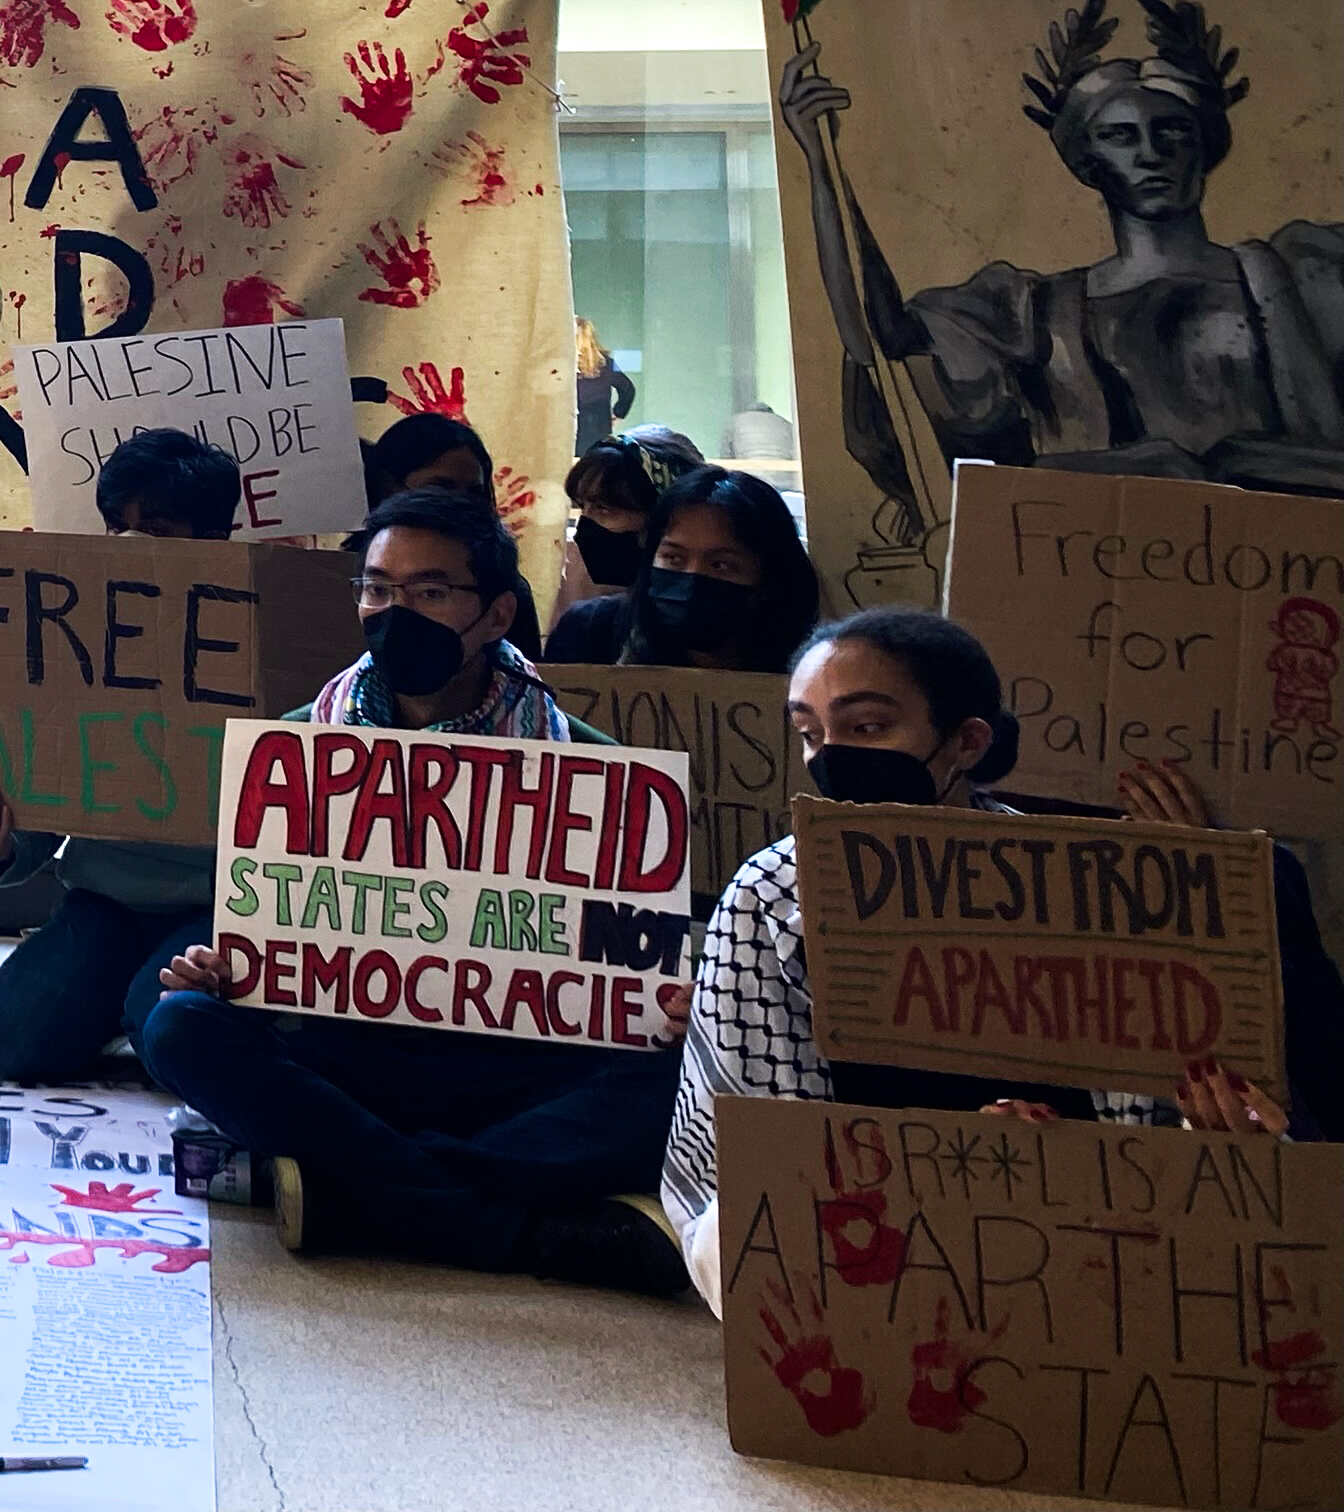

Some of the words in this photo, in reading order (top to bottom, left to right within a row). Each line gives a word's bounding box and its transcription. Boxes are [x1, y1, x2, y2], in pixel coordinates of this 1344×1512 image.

[31, 325, 310, 406] PALESINE
[268, 404, 321, 458] BE
[1013, 501, 1344, 594] Freedom
[1076, 600, 1214, 671] for
[1010, 676, 1339, 783] Palestine
[232, 729, 690, 893] APARTHEID
[225, 856, 450, 943] STATES
[470, 888, 570, 955] ARE
[579, 899, 691, 977] NOT
[841, 831, 1055, 923] DIVEST
[1067, 837, 1226, 939] FROM
[892, 944, 1223, 1058] APARTHEID
[1099, 1136, 1157, 1214] IS
[1184, 1142, 1283, 1229] AN
[959, 1354, 1325, 1508] STATE
